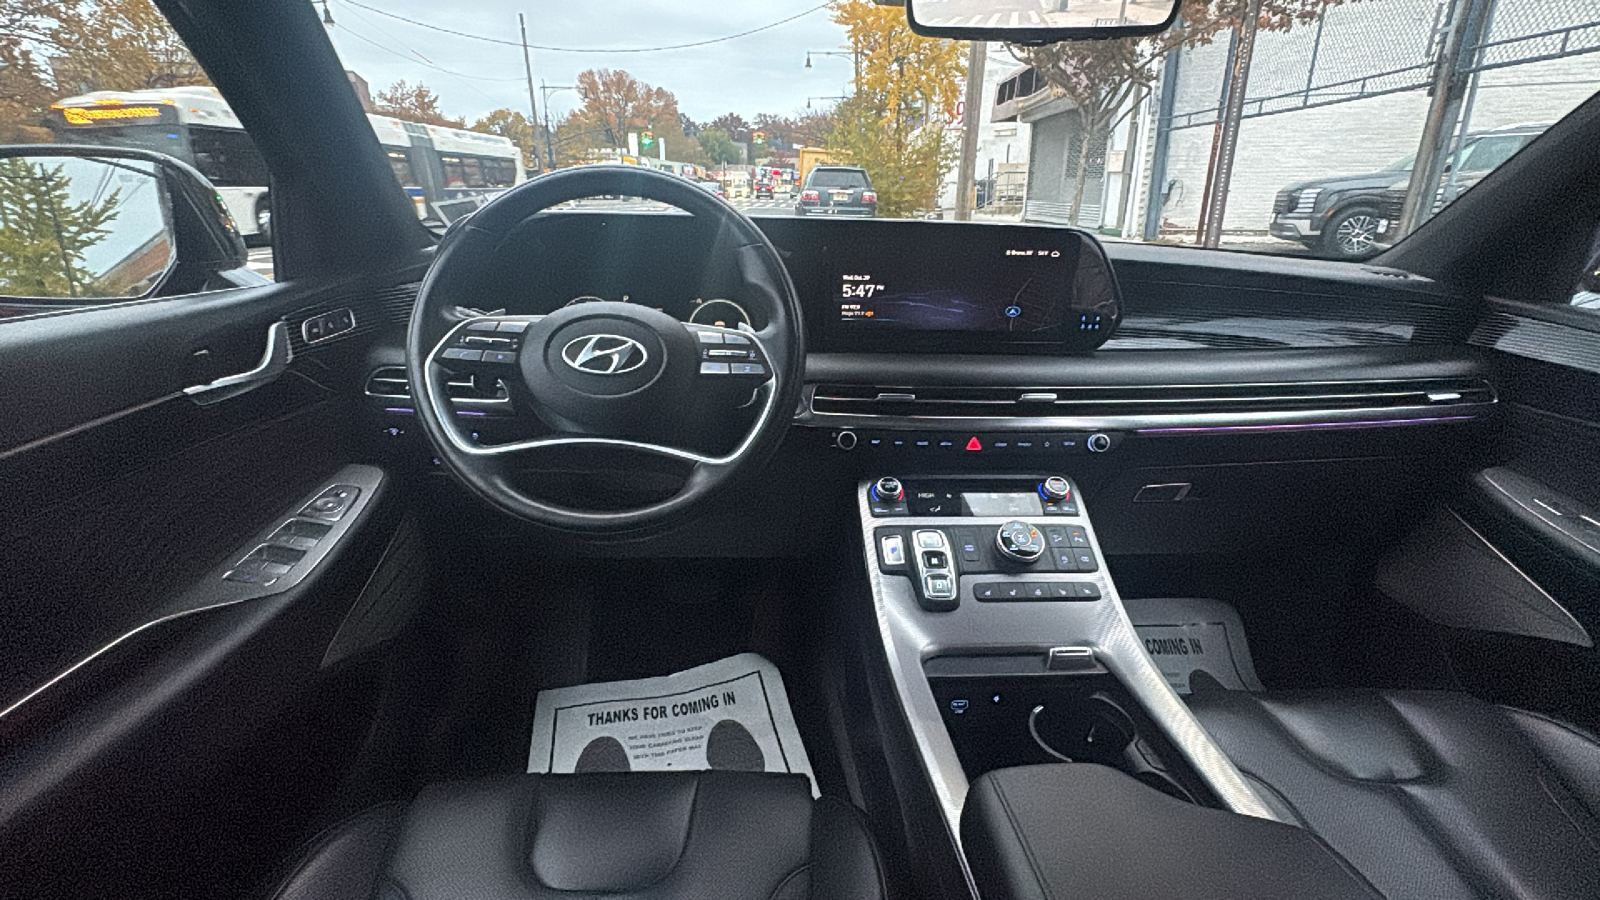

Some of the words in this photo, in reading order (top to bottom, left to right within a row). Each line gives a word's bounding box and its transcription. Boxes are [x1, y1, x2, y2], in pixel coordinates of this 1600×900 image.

[842, 284, 876, 298] 5:47
[1145, 637, 1188, 656] COMING
[1188, 637, 1204, 655] IN
[587, 707, 639, 726] THANKS
[643, 705, 668, 720] FOR
[671, 694, 719, 717] COMING
[722, 691, 736, 706] IN
